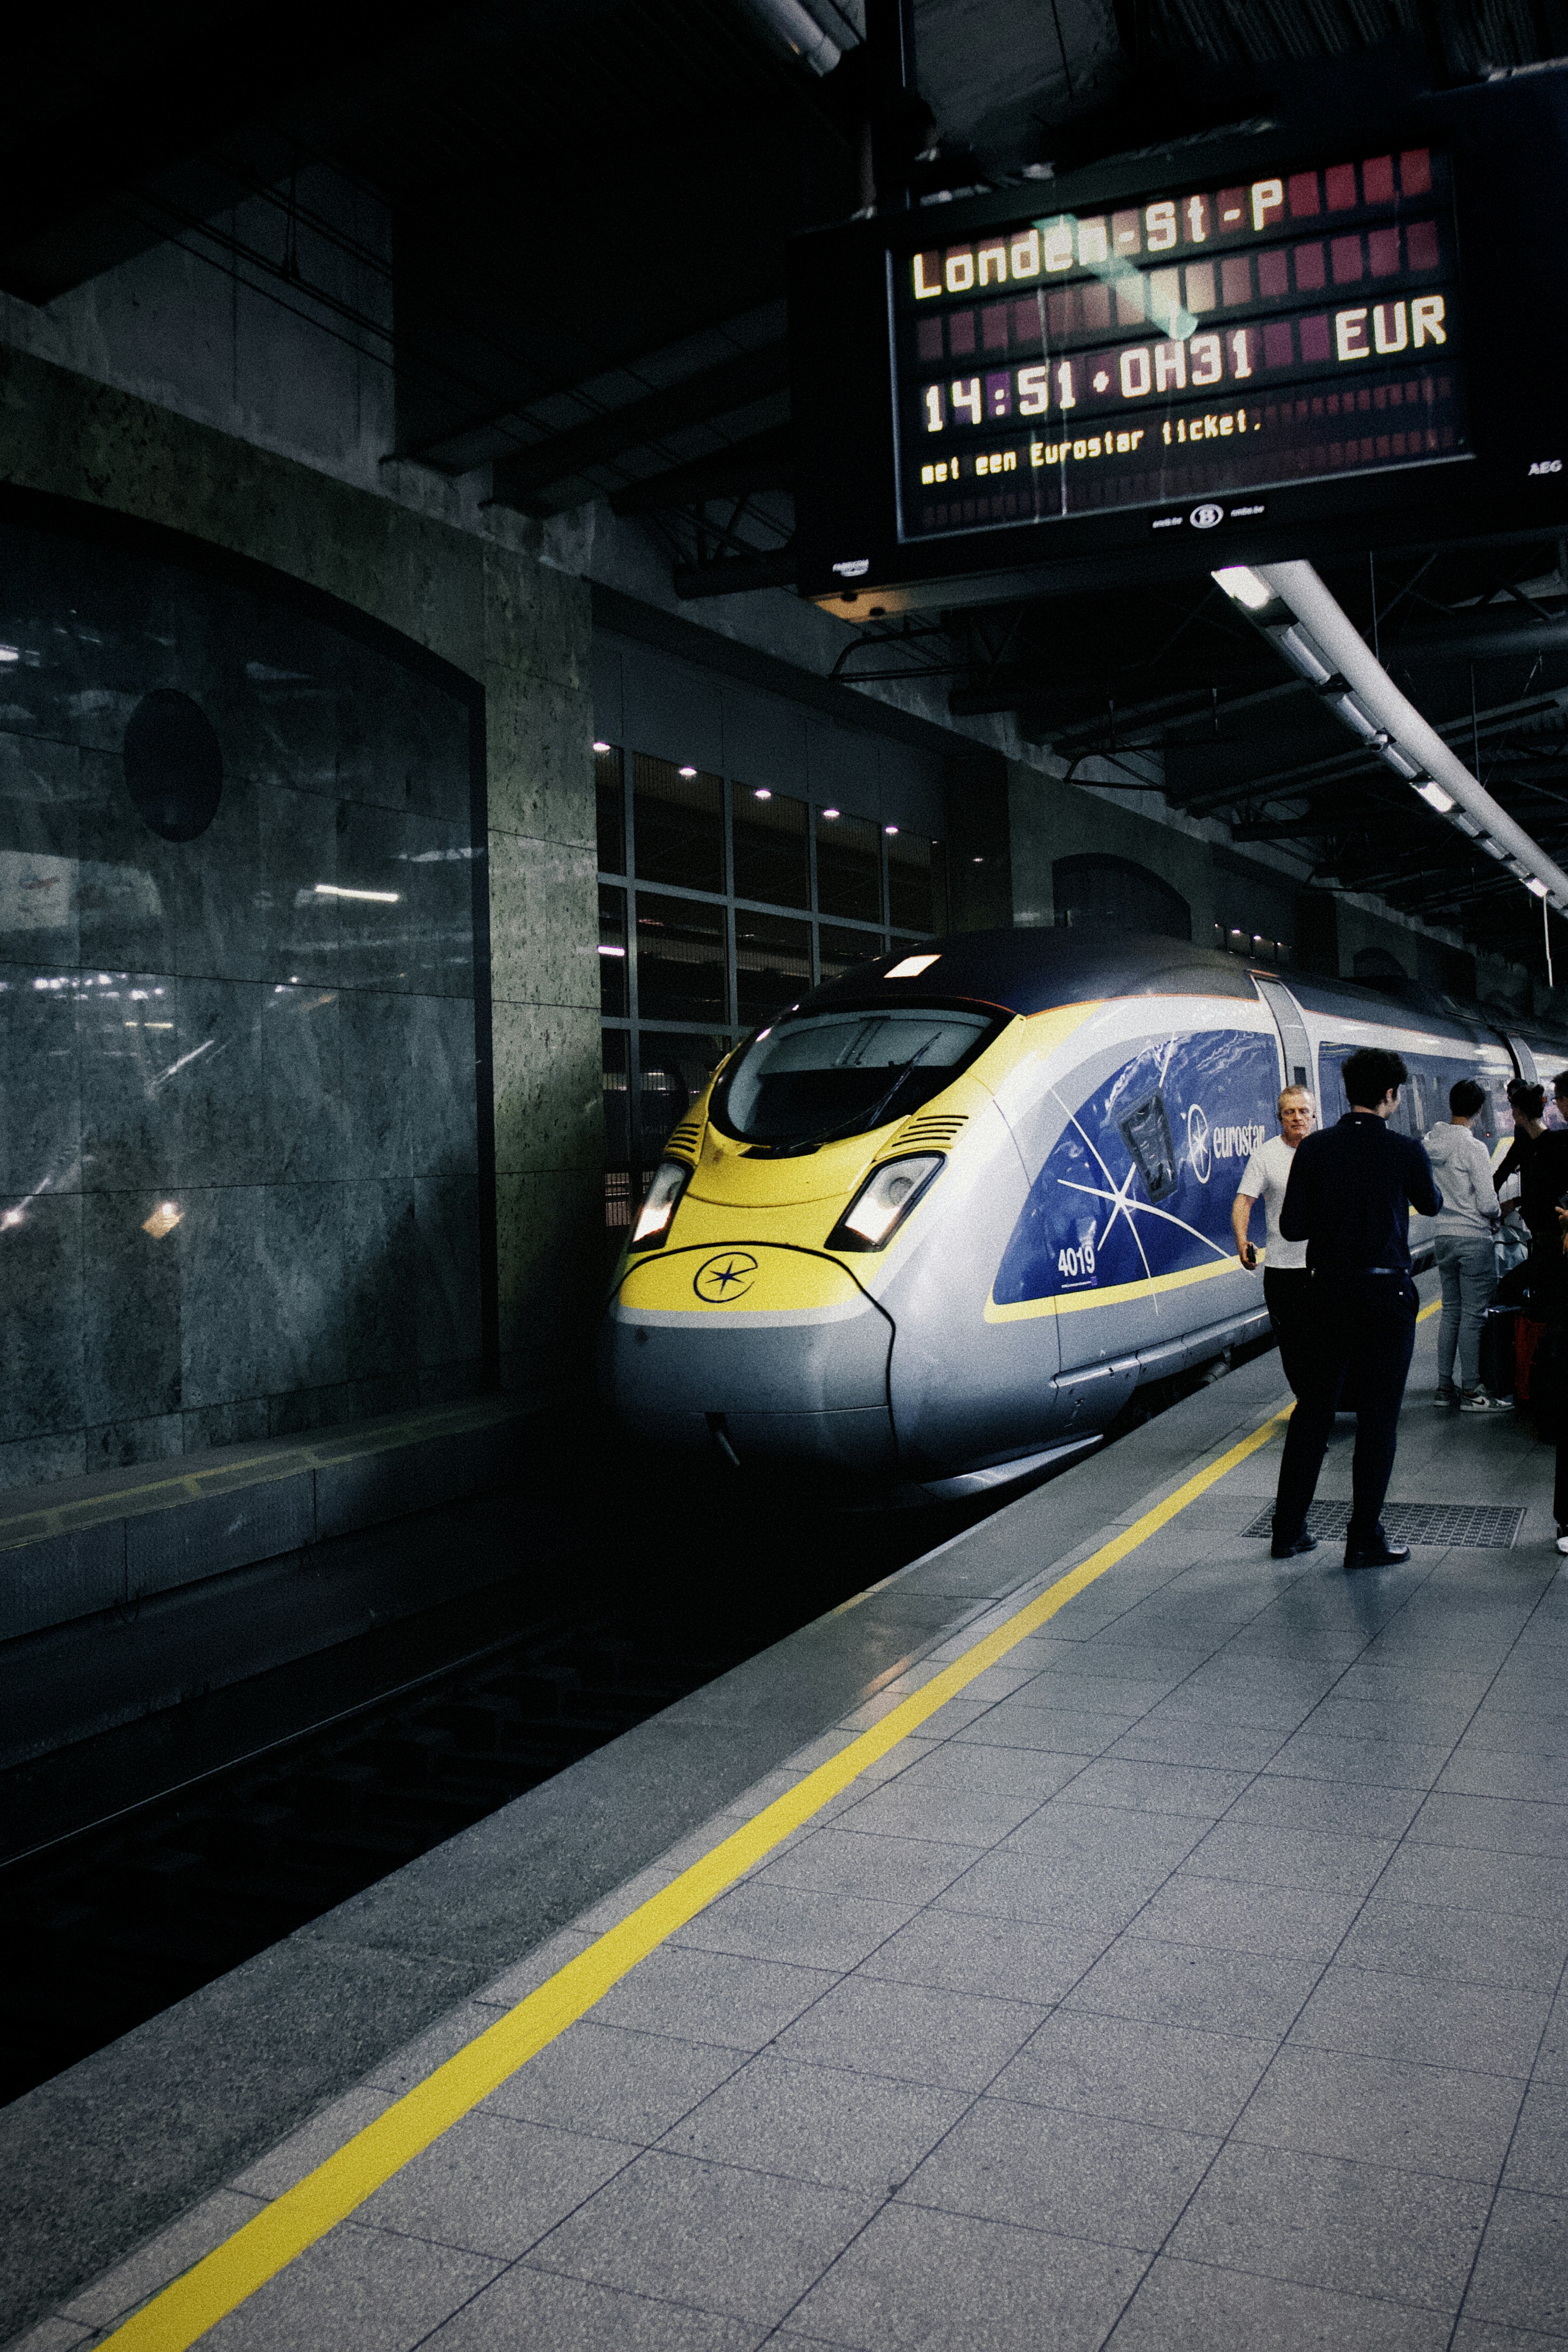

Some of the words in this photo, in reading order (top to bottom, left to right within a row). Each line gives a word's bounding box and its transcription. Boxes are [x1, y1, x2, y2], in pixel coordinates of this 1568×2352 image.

[913, 178, 1283, 300] Londen-St-P
[1335, 294, 1447, 361] EUR
[921, 456, 960, 485] met
[975, 451, 1017, 476] een
[1030, 430, 1145, 468] Eurostar
[1162, 408, 1262, 446] ticket.
[1527, 460, 1563, 476] AEG
[1213, 1119, 1265, 1159] eurostar
[1058, 1245, 1096, 1277] 4019
